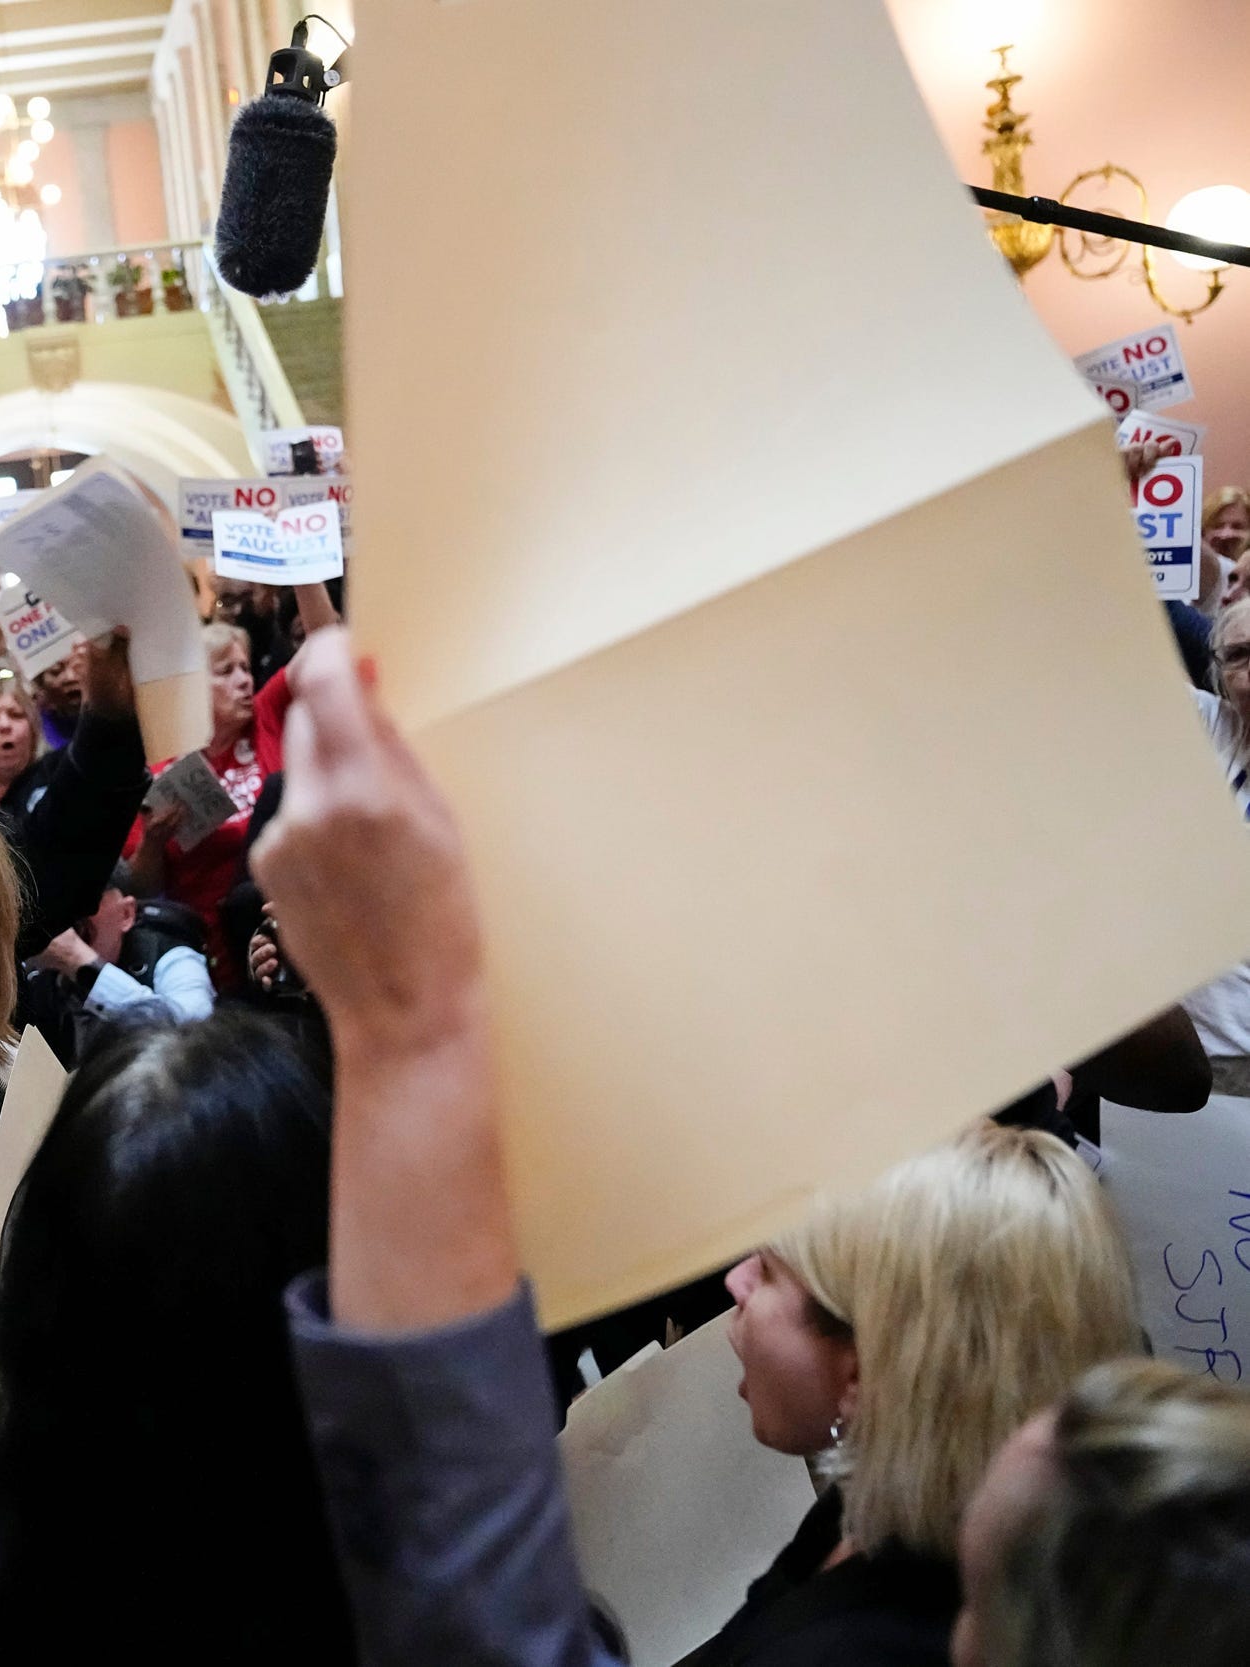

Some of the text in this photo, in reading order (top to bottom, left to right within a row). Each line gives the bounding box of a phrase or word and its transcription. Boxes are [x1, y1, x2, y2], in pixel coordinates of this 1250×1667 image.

[1123, 337, 1167, 364] NO
[1096, 385, 1130, 414] O
[235, 488, 276, 508] NO
[224, 523, 275, 538] VOTE
[281, 514, 327, 535] NO
[238, 535, 328, 554] AUGUST
[8, 607, 44, 635] ONE
[16, 616, 61, 650] ONE
